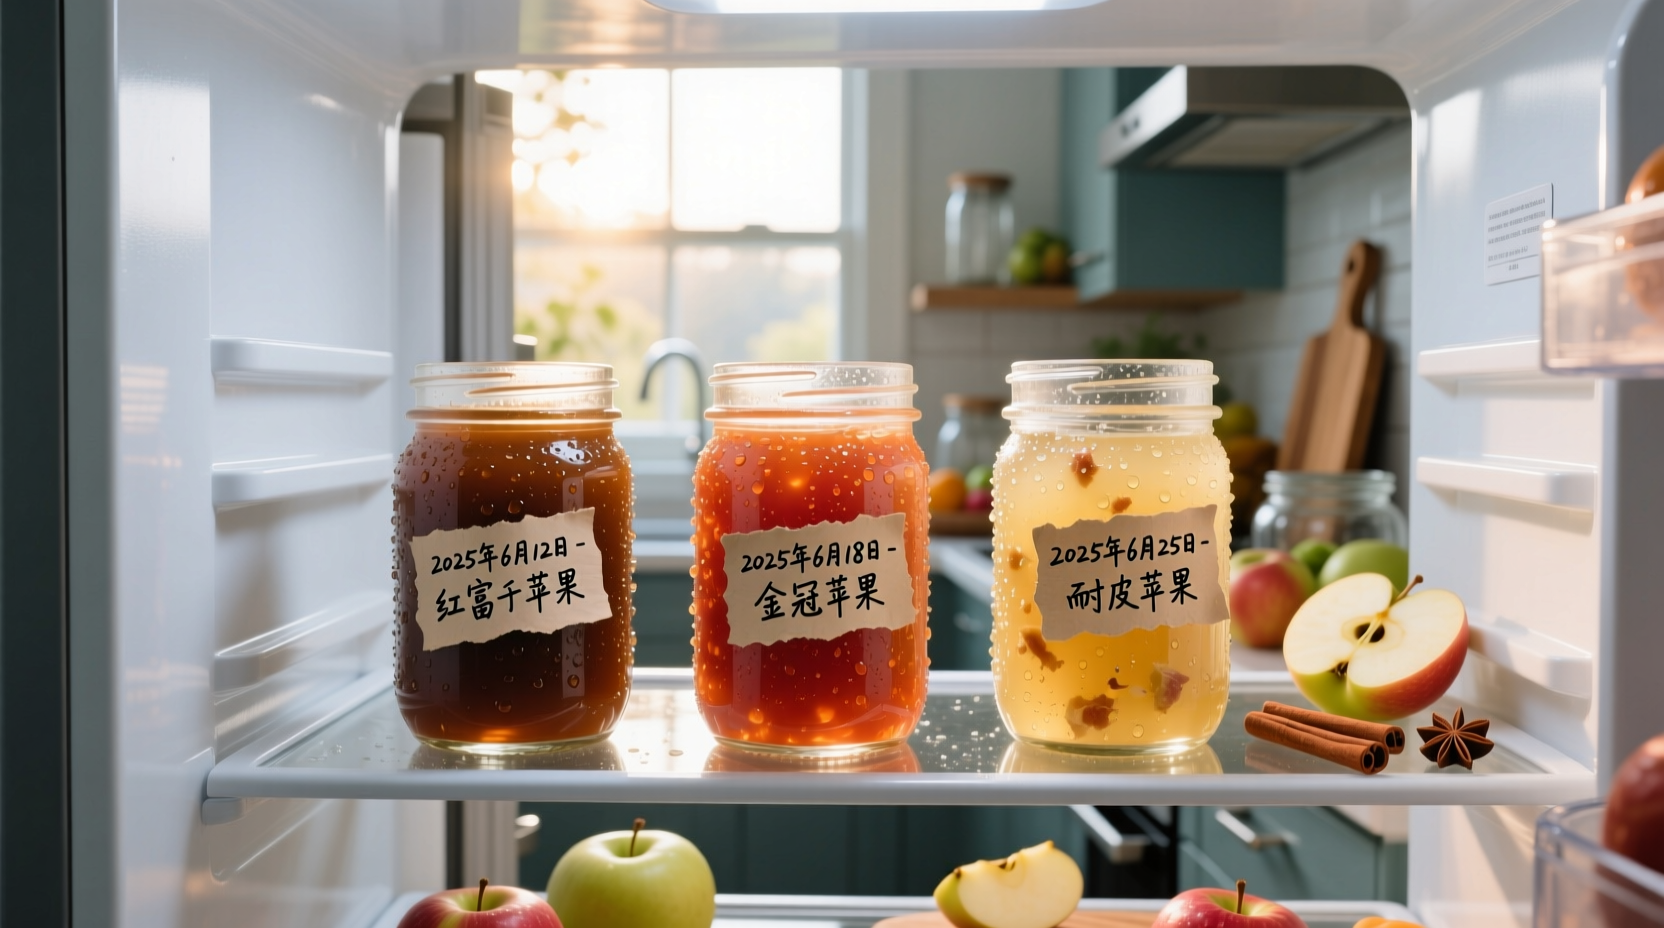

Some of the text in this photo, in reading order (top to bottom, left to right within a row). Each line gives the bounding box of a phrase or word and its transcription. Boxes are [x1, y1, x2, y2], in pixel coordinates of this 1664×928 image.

[1050, 532, 1210, 568] 2025年6月25日-
[435, 568, 586, 622] 红富千苹果
[754, 572, 885, 622] 金冠苹果
[1066, 567, 1198, 614] 耐皮苹果
